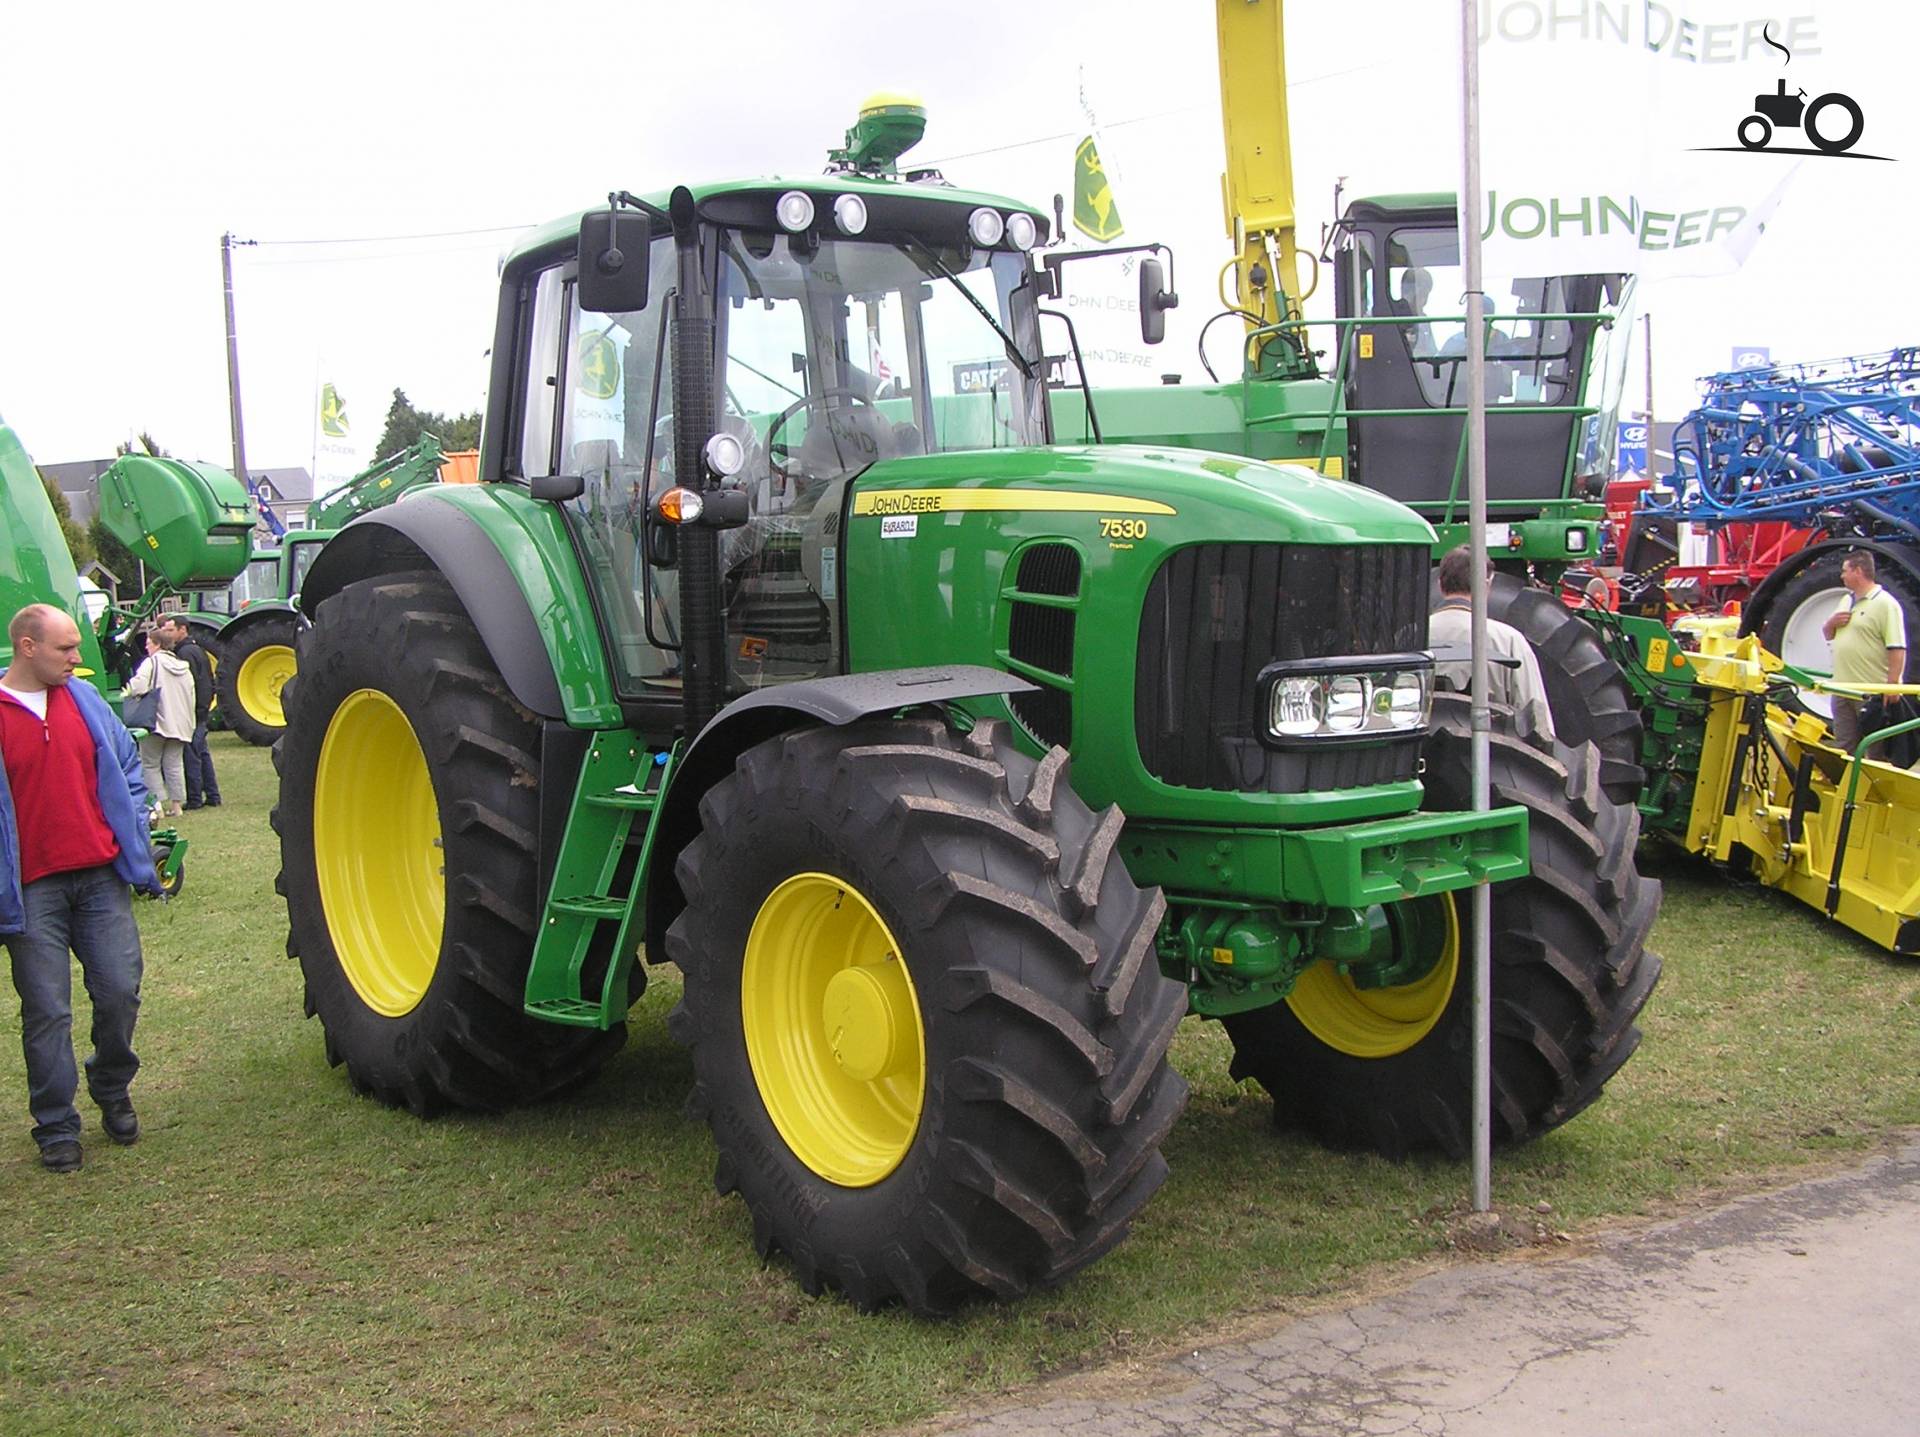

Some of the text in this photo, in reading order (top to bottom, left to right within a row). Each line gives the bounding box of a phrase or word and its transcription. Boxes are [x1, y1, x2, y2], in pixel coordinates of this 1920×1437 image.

[1477, 0, 1822, 65] JOHN DEERE
[1480, 190, 1638, 243] JOHN
[1106, 295, 1137, 313] DEE
[869, 495, 941, 512] JOHN DEERE
[1099, 518, 1148, 539] 7530
